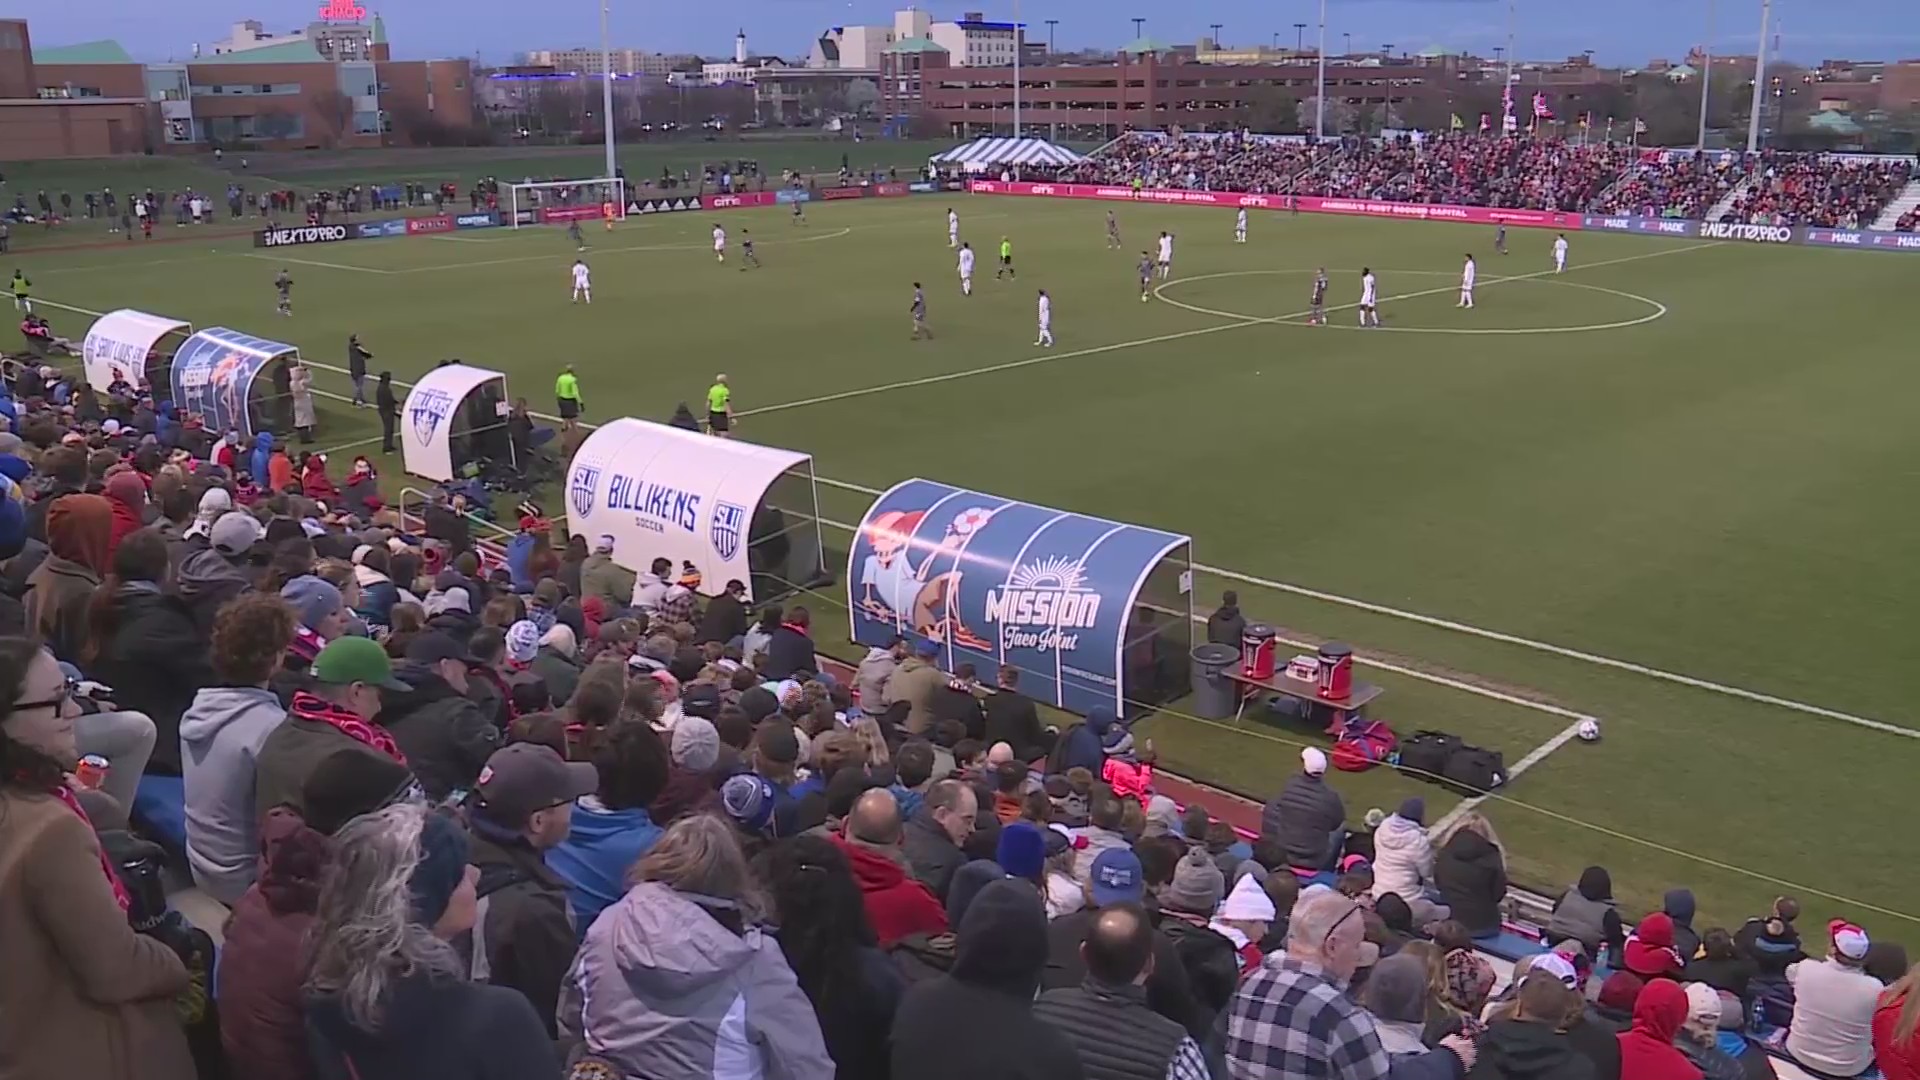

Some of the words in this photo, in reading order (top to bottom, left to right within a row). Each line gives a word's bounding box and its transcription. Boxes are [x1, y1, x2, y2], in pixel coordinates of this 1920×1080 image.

[607, 474, 701, 532] BILLIKENS
[635, 516, 664, 534] SOCCER
[985, 589, 1101, 628] MISSION
[1004, 626, 1037, 649] Taco
[1037, 627, 1079, 652] Joint
